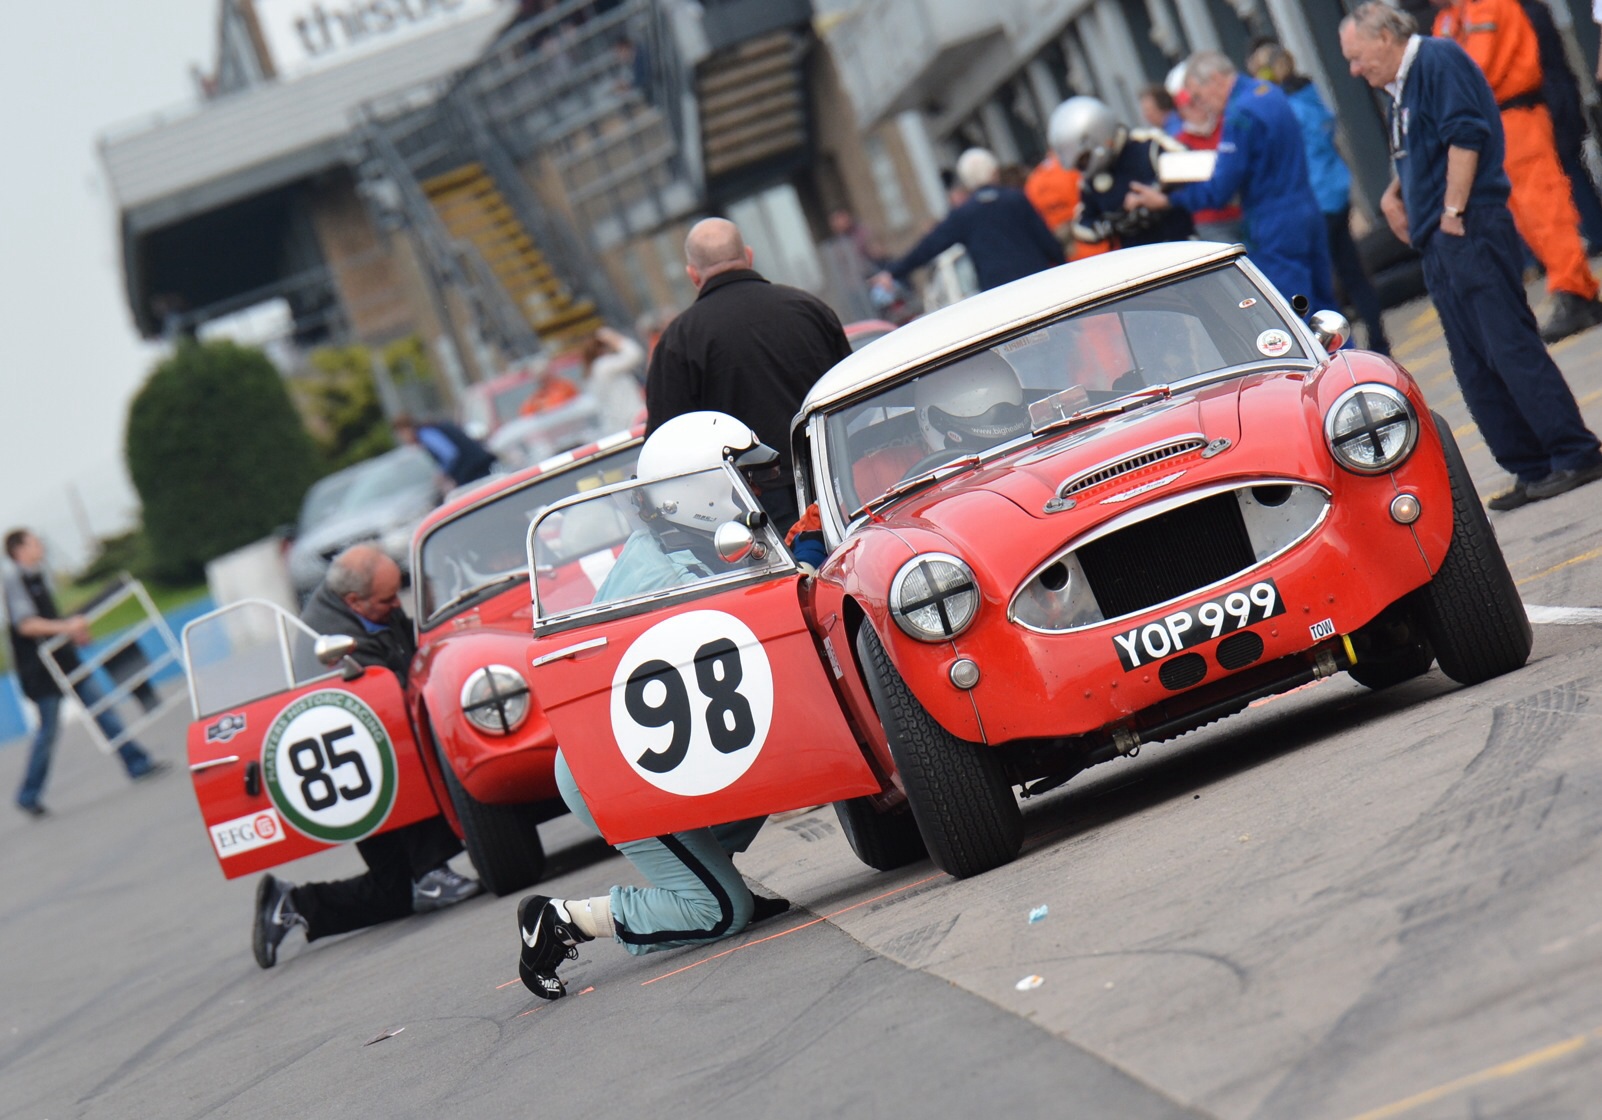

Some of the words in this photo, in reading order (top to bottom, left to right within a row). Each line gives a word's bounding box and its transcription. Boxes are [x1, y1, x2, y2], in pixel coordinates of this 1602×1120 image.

[1114, 611, 1193, 667] YOP
[1198, 583, 1276, 638] 999
[1311, 621, 1333, 638] TOW
[265, 716, 289, 781] MASTERS
[286, 692, 345, 718] HISTORIC
[343, 697, 386, 743] RACING
[625, 637, 756, 774] 98
[289, 725, 372, 812] 85
[218, 823, 256, 849] EFG
